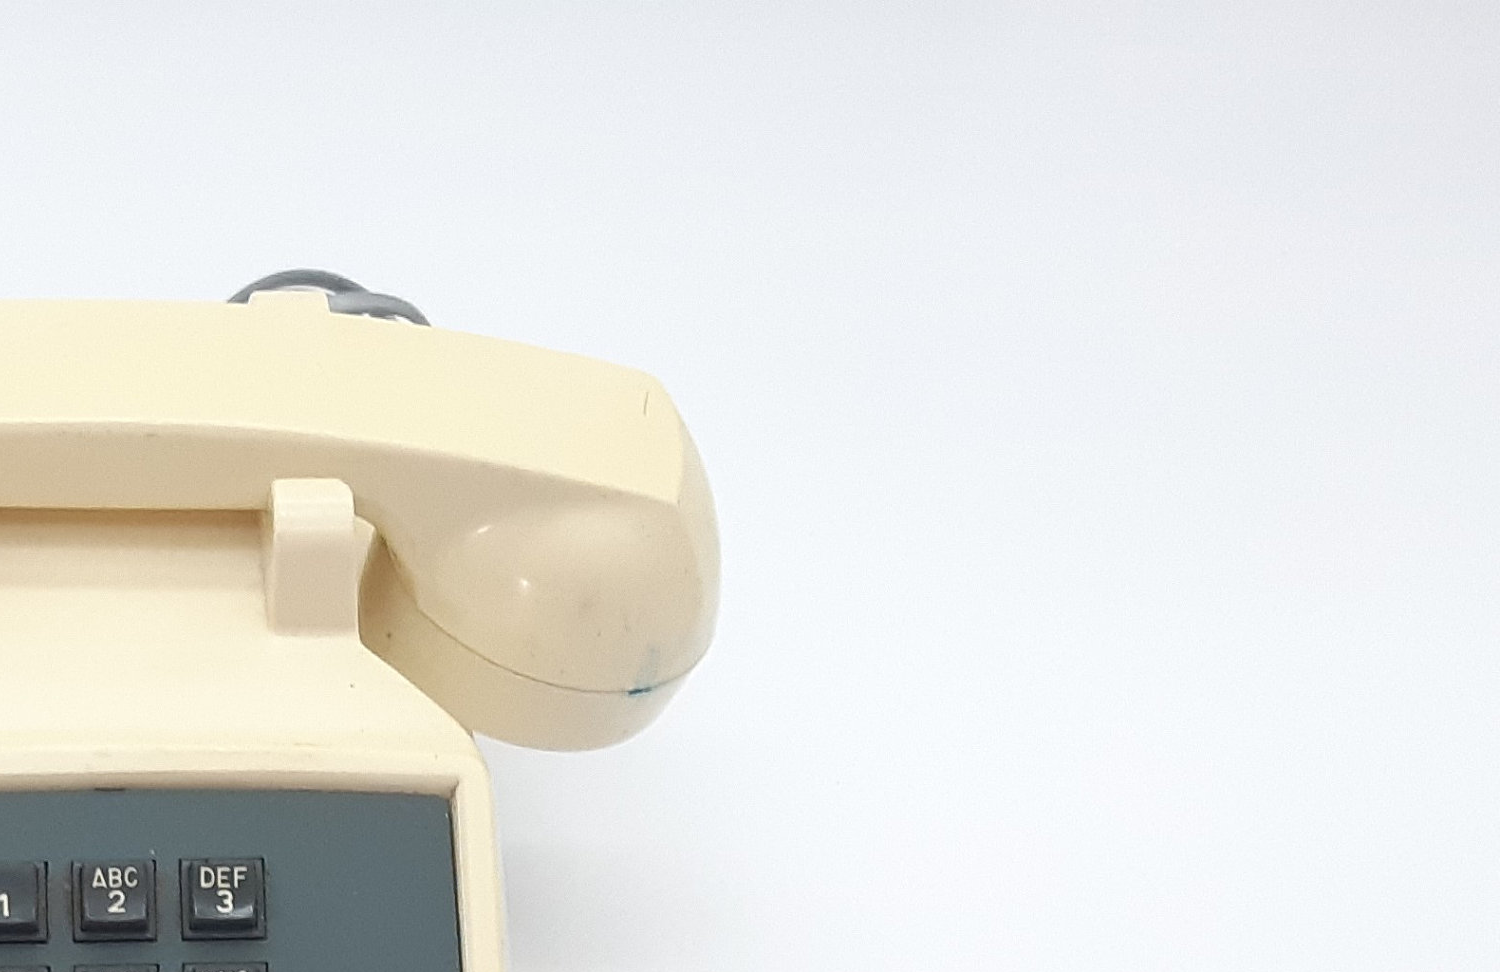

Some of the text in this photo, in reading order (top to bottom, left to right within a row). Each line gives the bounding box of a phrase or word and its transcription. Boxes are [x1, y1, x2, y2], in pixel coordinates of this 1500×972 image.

[91, 866, 139, 889] ABC
[199, 865, 248, 889] DEF
[106, 889, 127, 914] 2
[215, 889, 235, 915] 3
